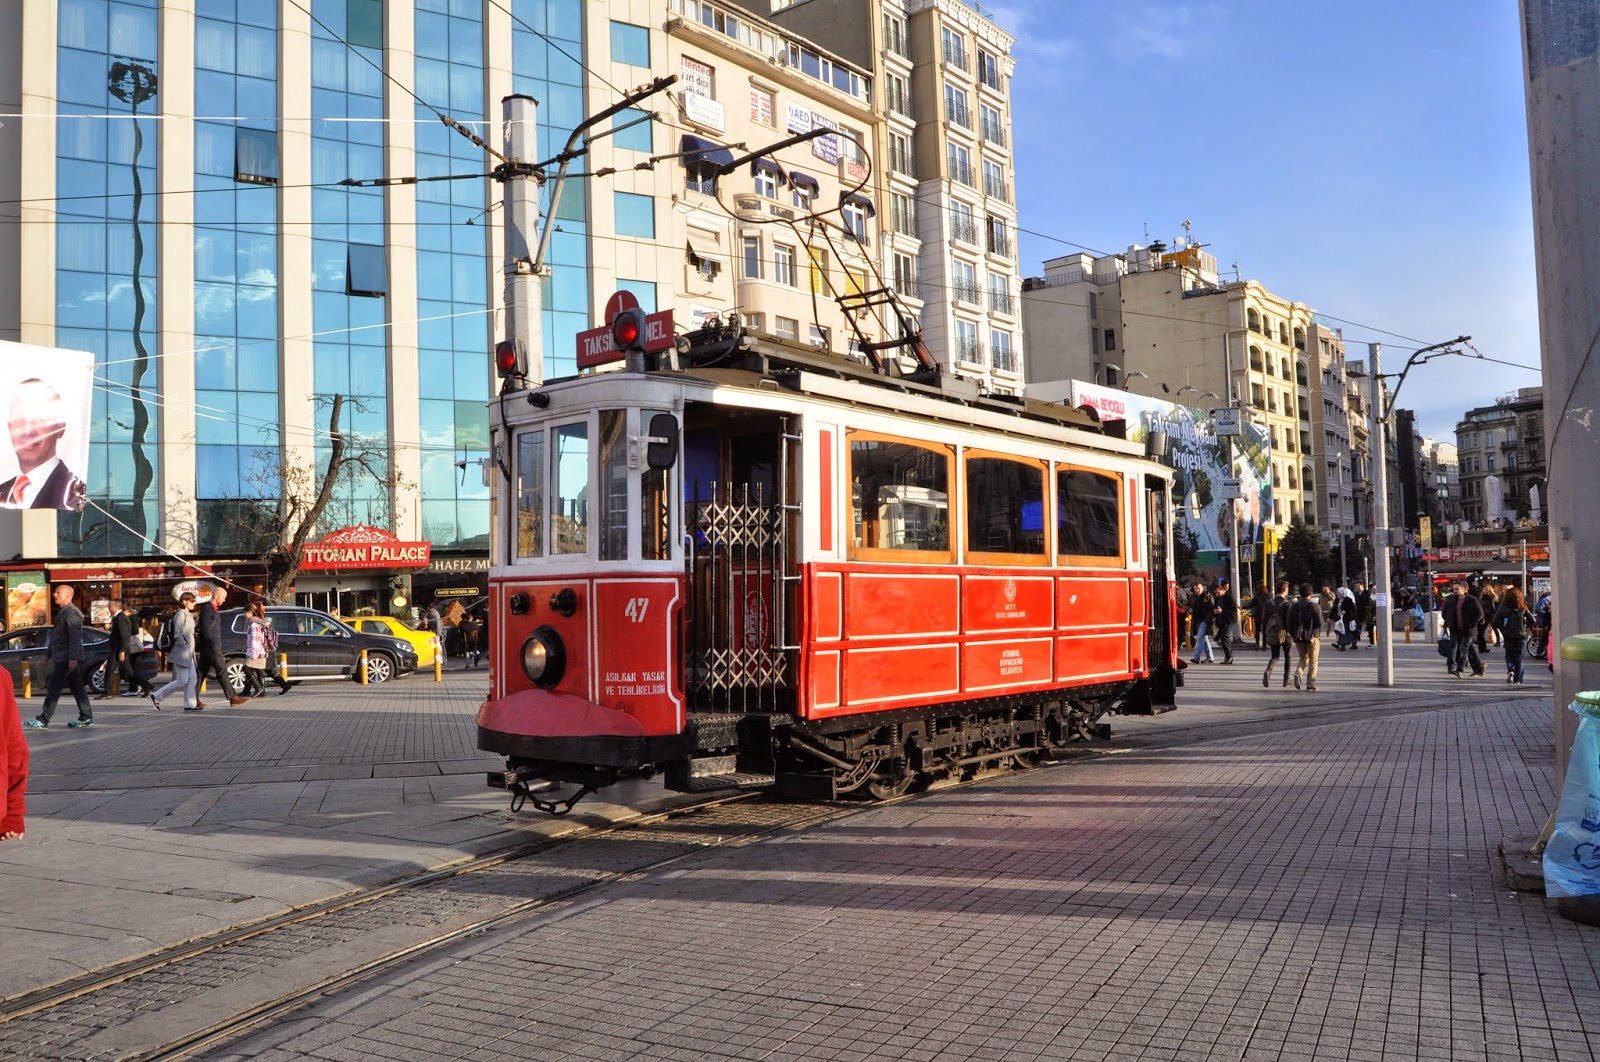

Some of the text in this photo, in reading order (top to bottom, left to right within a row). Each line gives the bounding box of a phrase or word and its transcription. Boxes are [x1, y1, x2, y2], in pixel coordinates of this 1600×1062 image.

[583, 329, 614, 356] TAKSİ
[1146, 413, 1181, 439] Taksim
[1172, 446, 1202, 474] Projesi
[301, 545, 427, 562] TTOMAN PALACE
[435, 560, 472, 570] HAFIZ
[625, 598, 649, 622] 47
[605, 672, 665, 682] ASILMAK YASAK
[605, 685, 615, 696] VE
